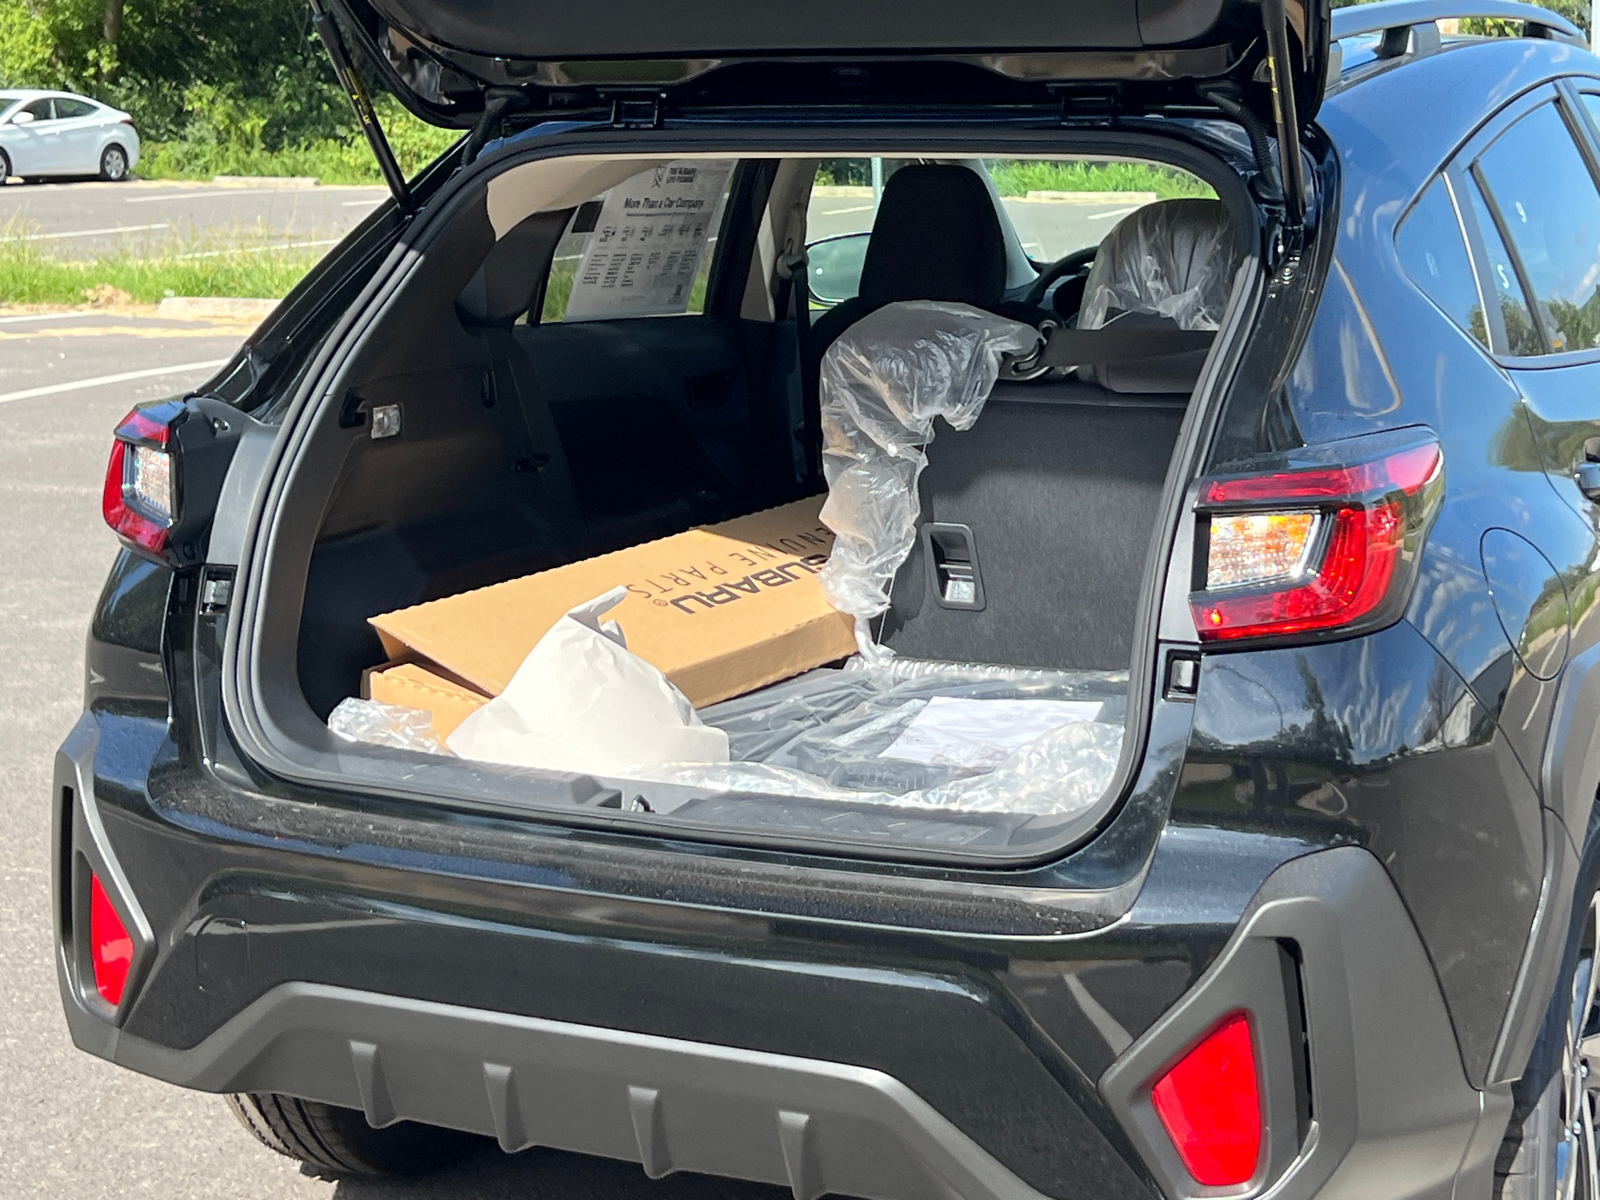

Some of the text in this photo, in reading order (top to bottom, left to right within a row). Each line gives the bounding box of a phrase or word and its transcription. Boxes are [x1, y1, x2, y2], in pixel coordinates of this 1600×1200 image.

[624, 197, 641, 208] More
[642, 197, 659, 208] Than
[664, 197, 676, 208] Car
[676, 197, 705, 210] Company
[626, 527, 836, 599] ENUINE PARTS
